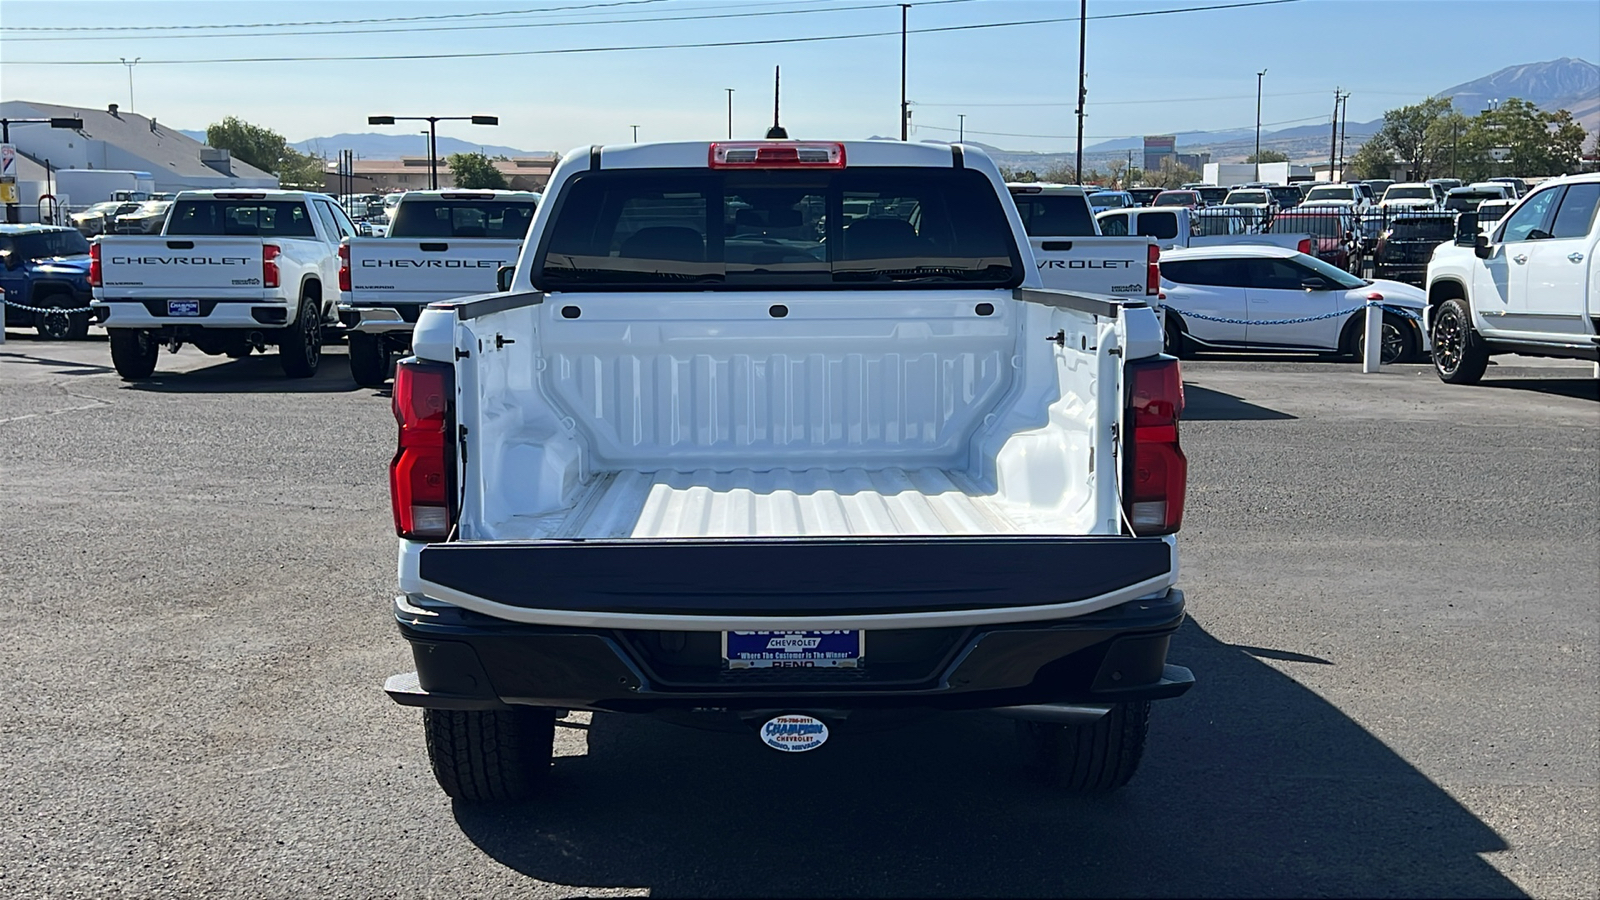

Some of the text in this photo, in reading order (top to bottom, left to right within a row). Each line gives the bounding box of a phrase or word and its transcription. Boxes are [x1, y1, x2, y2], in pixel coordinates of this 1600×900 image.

[112, 256, 251, 265] CHEVROLET
[362, 259, 507, 268] CHEVROLET
[765, 722, 824, 736] CHAMPION
[791, 739, 822, 751] NEVADA
